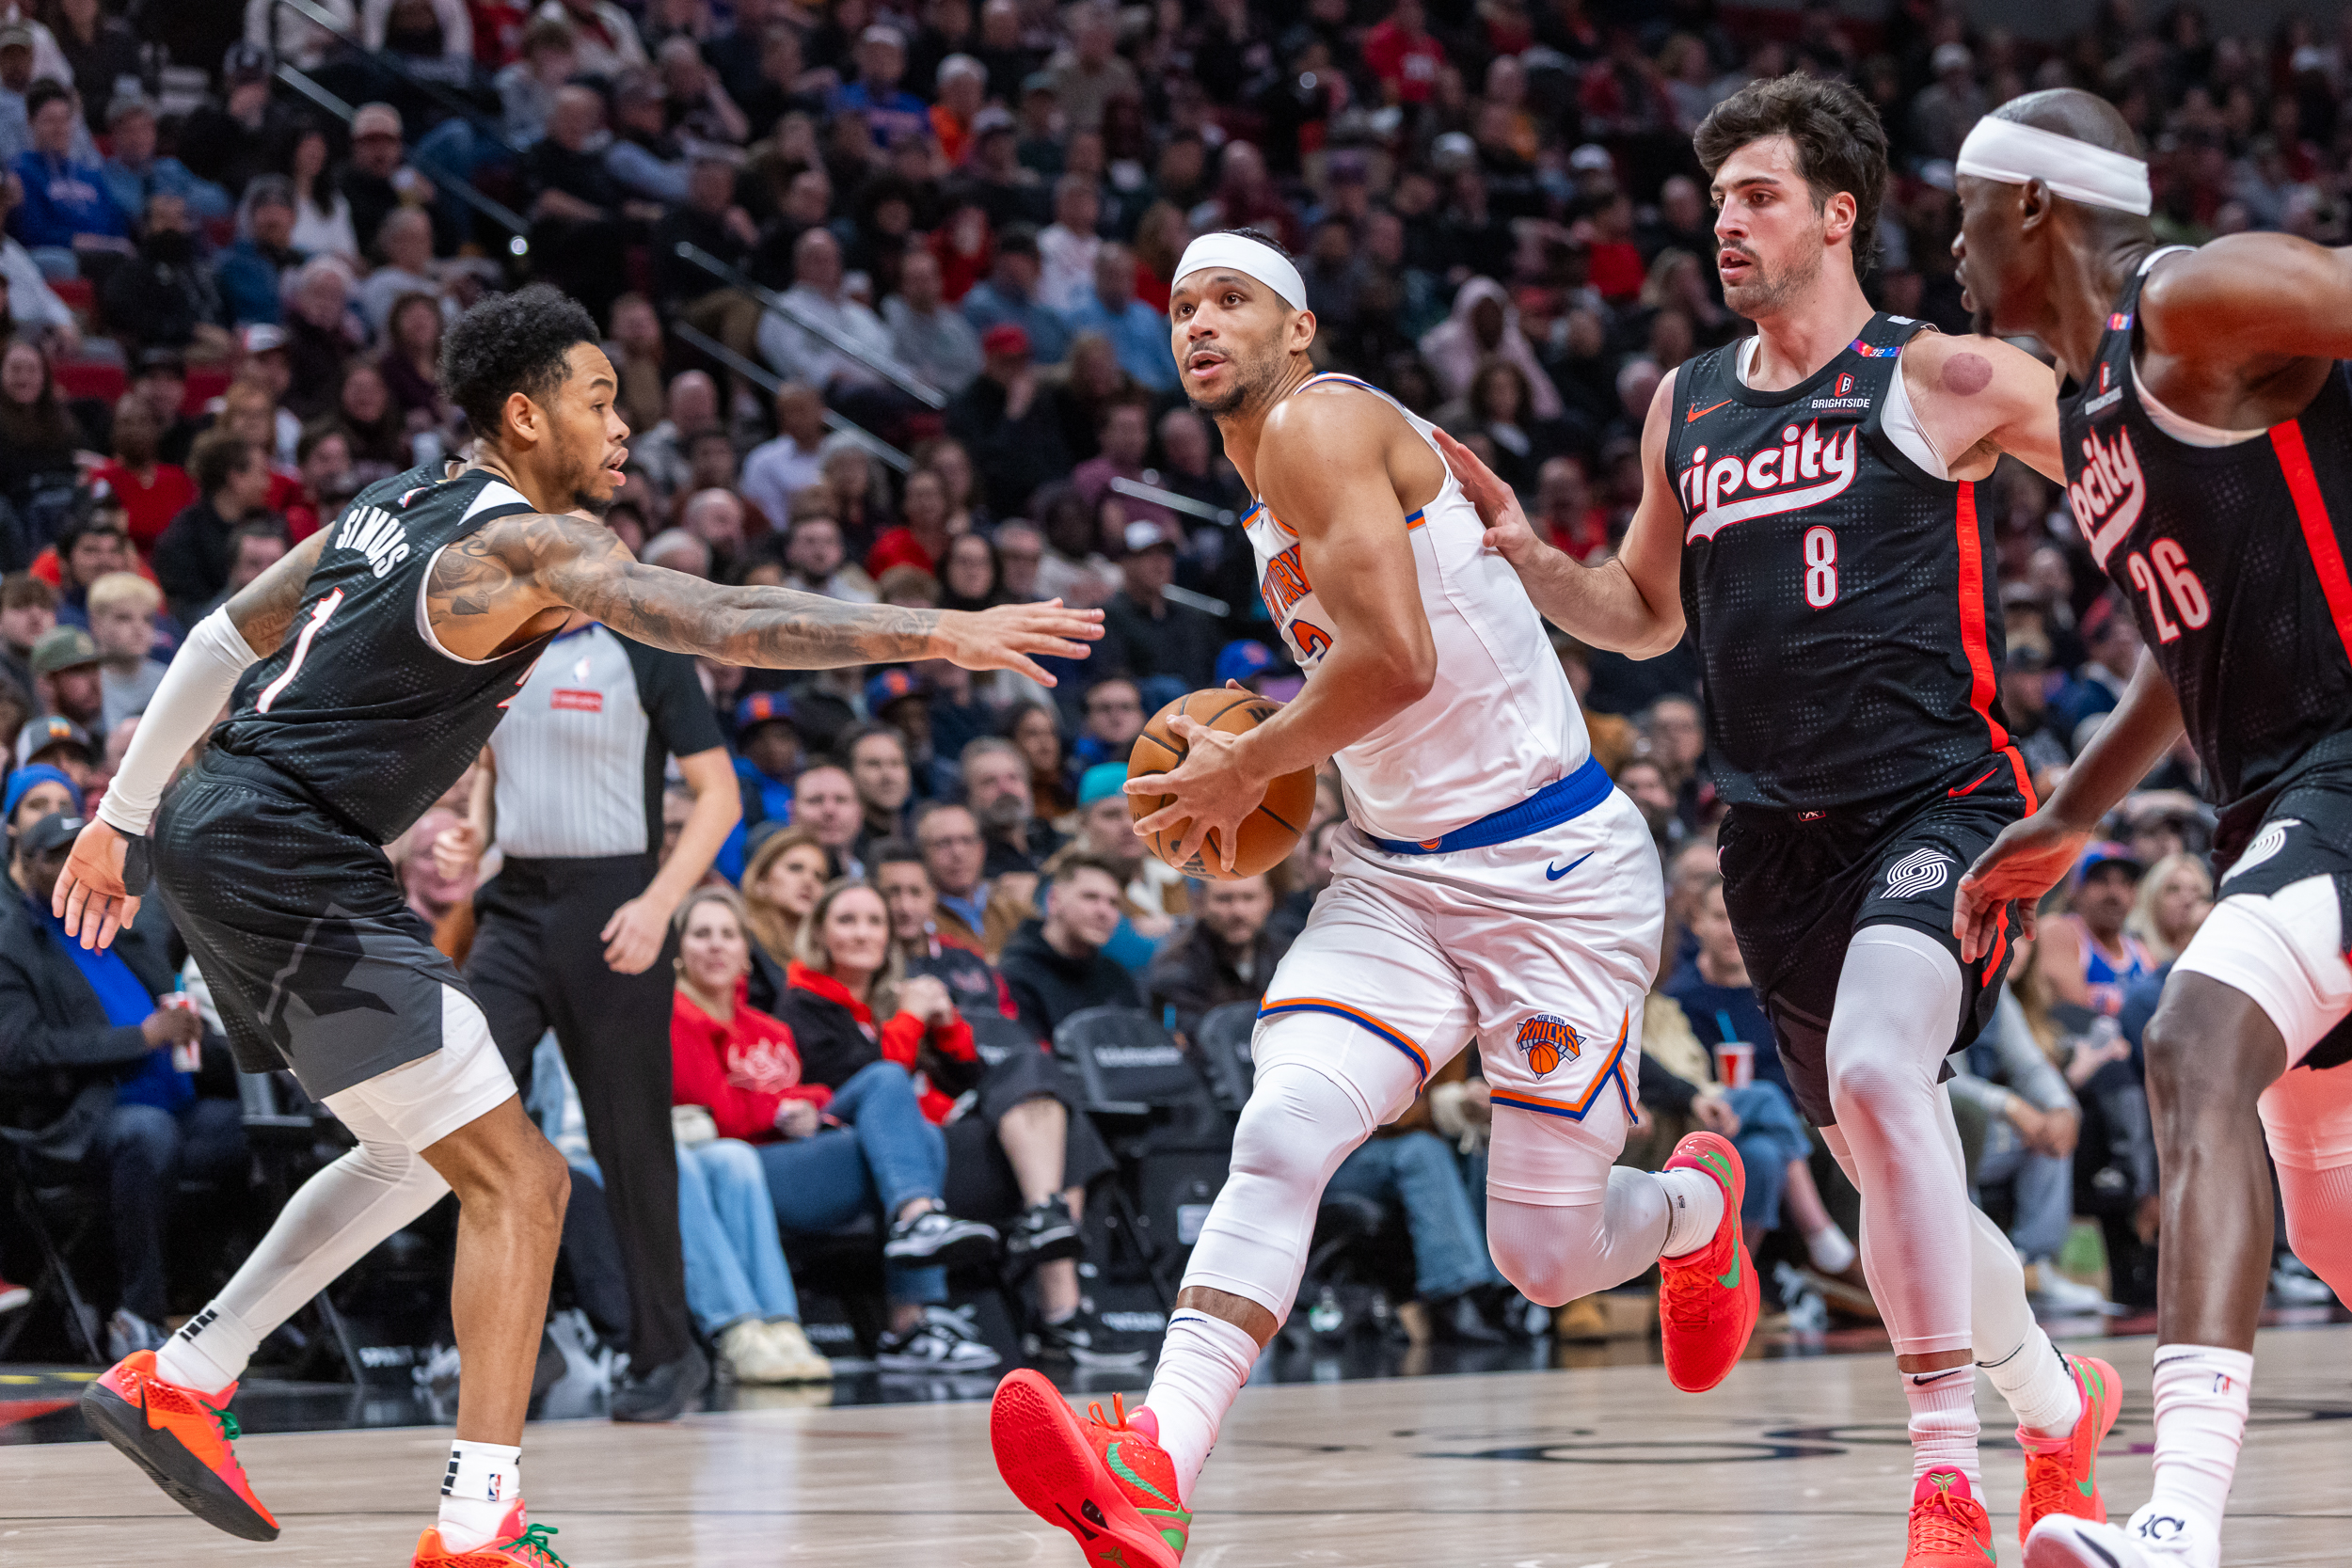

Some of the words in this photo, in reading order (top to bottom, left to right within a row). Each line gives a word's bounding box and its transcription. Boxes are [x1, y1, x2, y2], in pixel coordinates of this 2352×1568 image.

[1811, 398, 1871, 409] BRIGHTSIDE
[335, 505, 410, 578] SIMONS
[1804, 525, 1839, 610] 8
[2127, 537, 2212, 645] 26
[255, 586, 345, 714] 1
[1516, 1017, 1581, 1057] KNICKS
